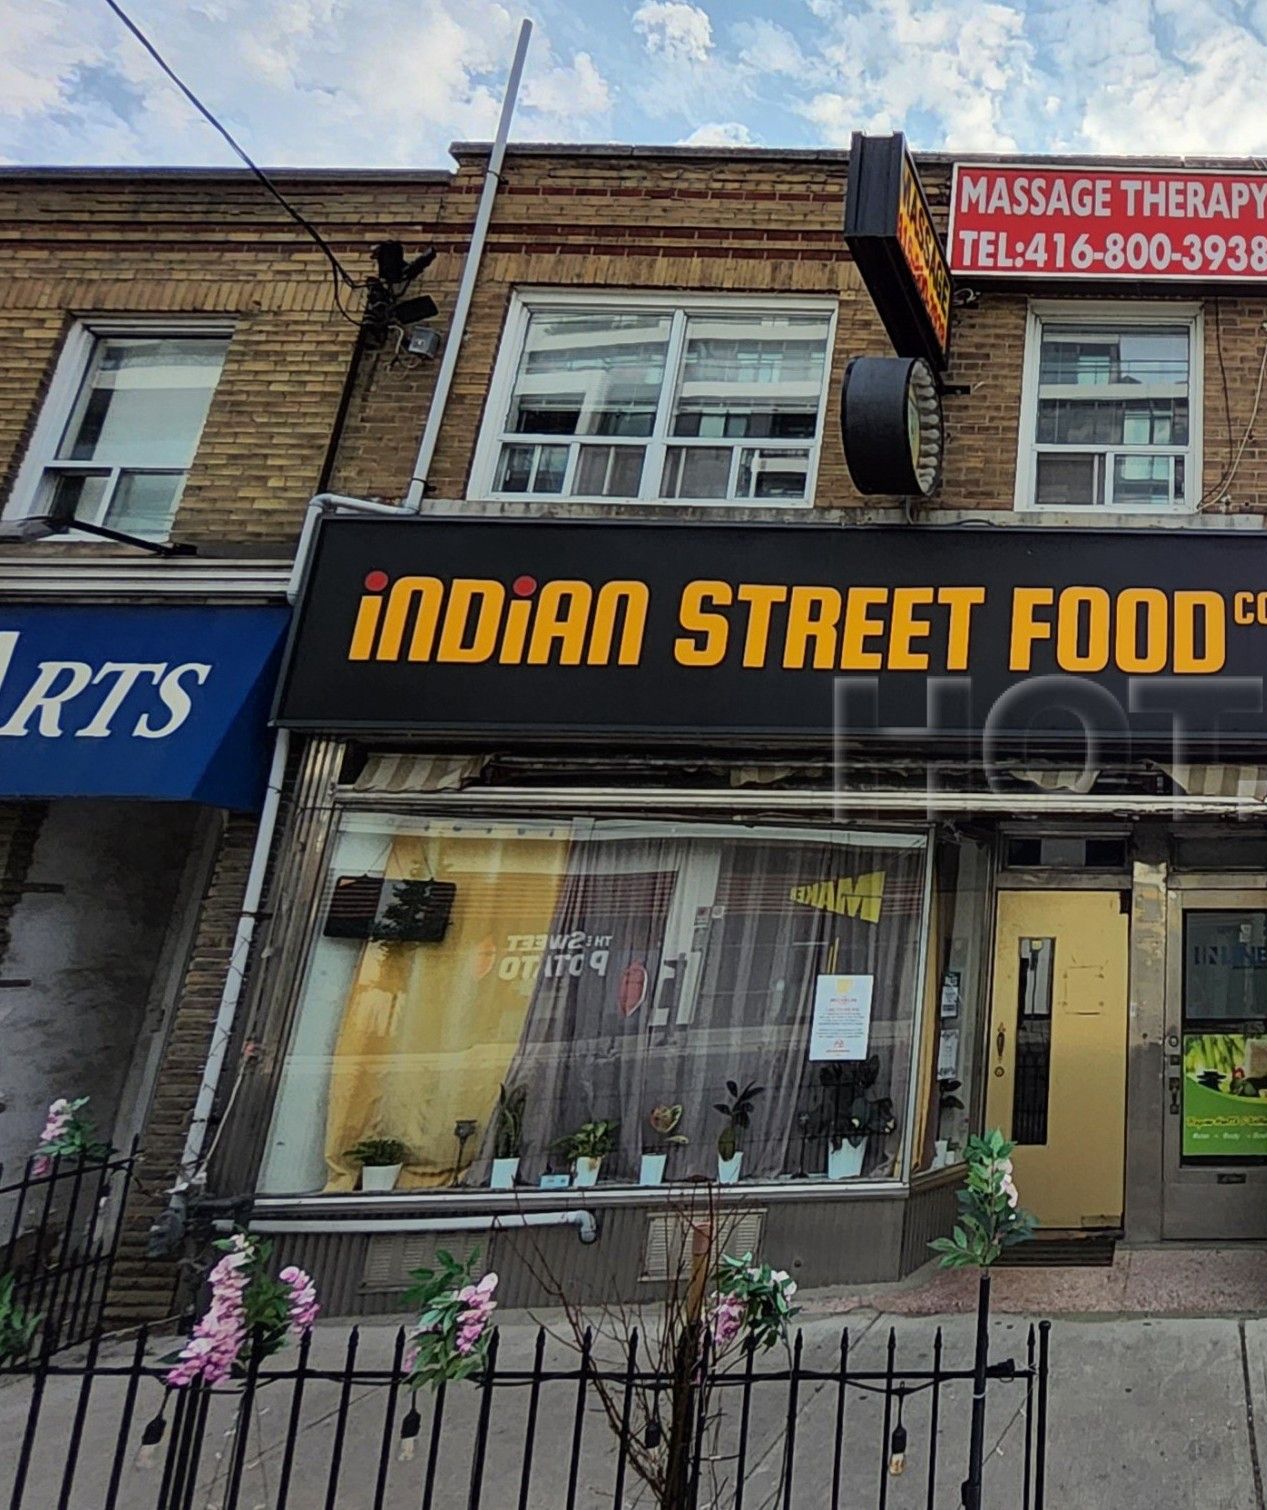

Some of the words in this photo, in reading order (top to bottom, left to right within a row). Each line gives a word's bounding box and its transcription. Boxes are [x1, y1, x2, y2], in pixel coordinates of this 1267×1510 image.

[960, 176, 1112, 217] MASSAGE
[674, 580, 986, 670] STREET
[1008, 585, 1227, 674] FOOD
[0, 631, 212, 738] RTS
